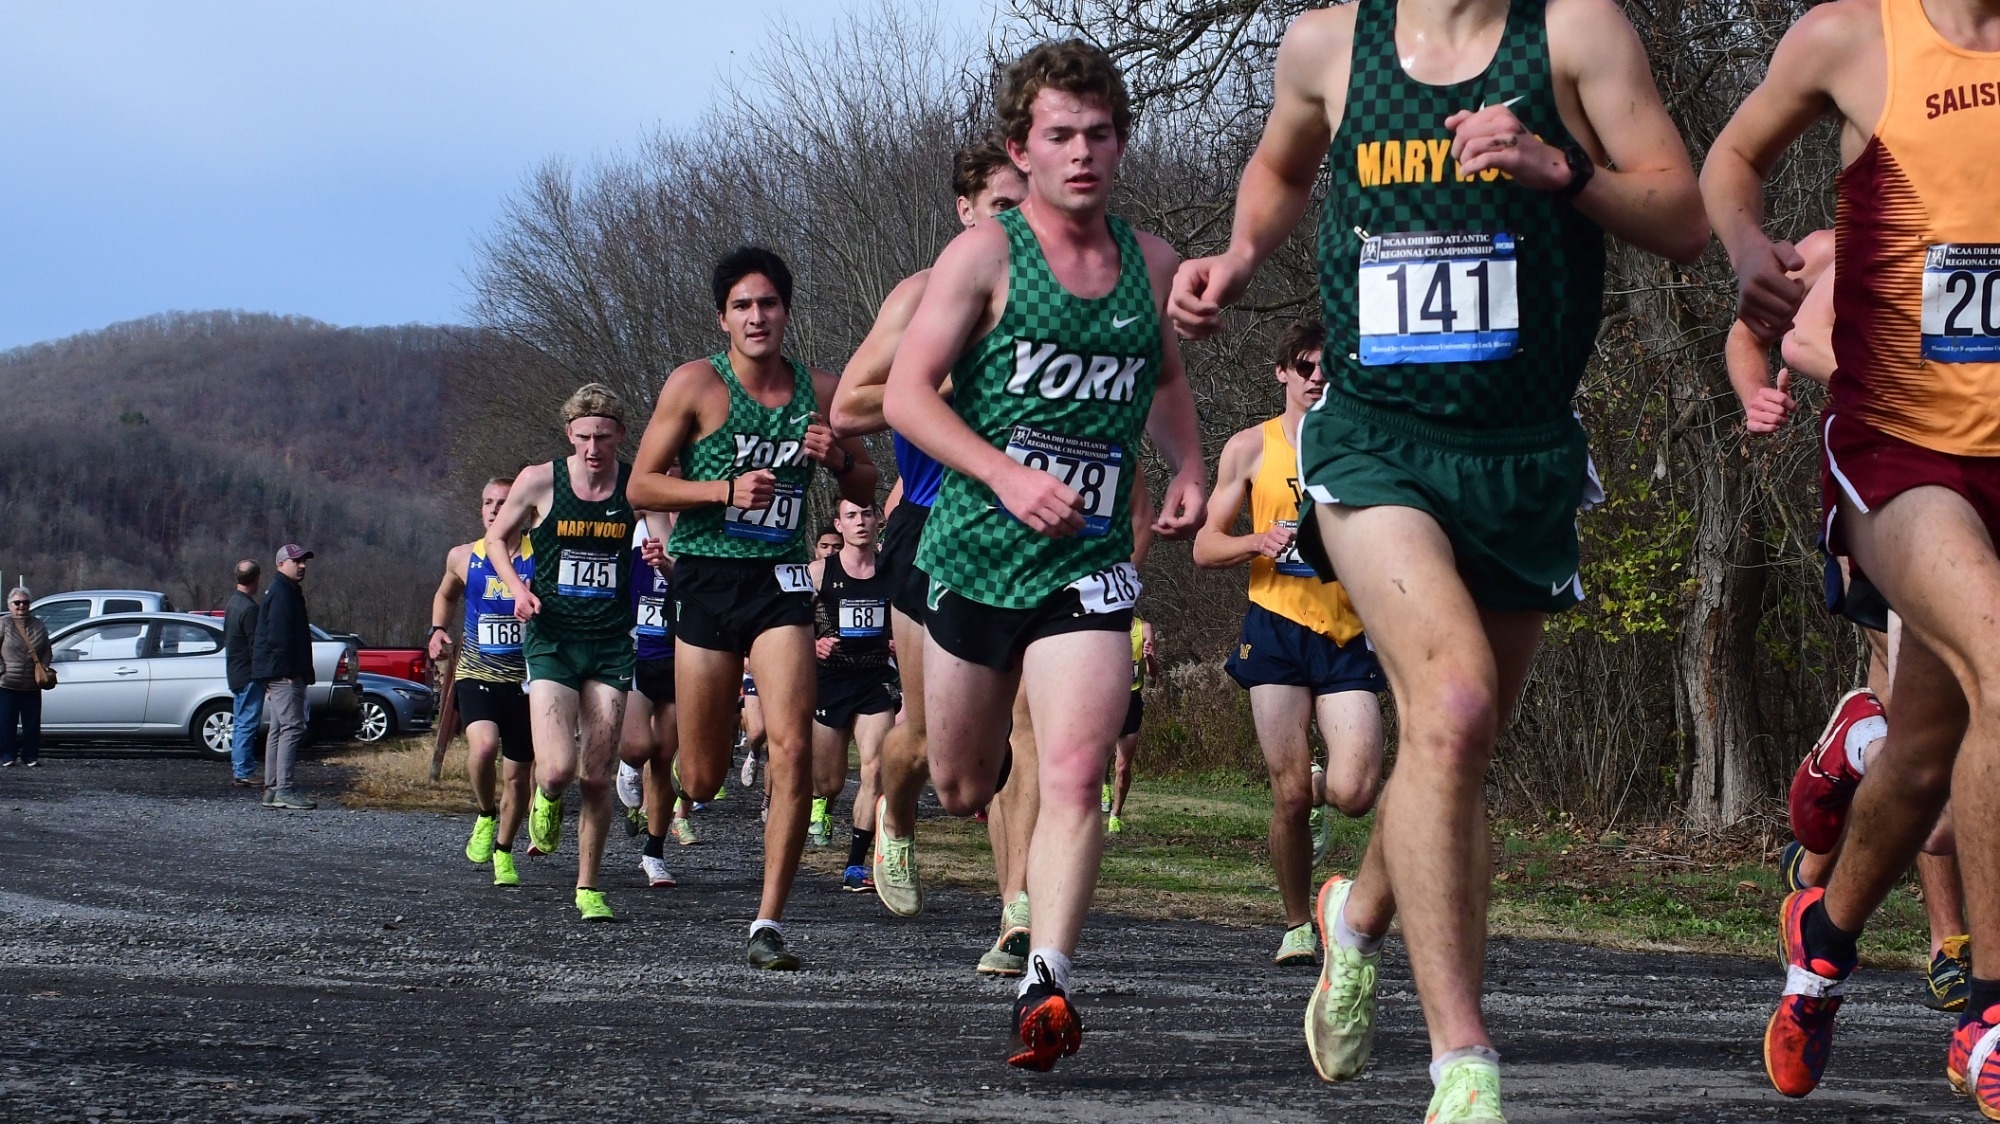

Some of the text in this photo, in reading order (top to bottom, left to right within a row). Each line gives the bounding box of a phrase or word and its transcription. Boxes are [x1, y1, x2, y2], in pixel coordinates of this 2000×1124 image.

[1926, 82, 2000, 120] SALIS
[1357, 134, 1543, 187] MARY
[1383, 234, 1490, 247] NCAA DIII MID ATLANTIC
[1948, 247, 1972, 255] NCAA
[1973, 247, 1989, 255] DIII
[1380, 246, 1494, 259] REGIONAL CHAMPIONSHIP
[1945, 258, 1987, 266] REGIONAL
[1387, 260, 1490, 335] 141
[1005, 337, 1146, 402] YORK
[1027, 439, 1110, 459] REGIONAL CHAMPIONSHIP
[1032, 431, 1051, 441] NCAA
[1065, 438, 1079, 446] MID
[1080, 440, 1108, 451] ATLANTIC
[557, 520, 627, 539] MARYWOOD
[571, 560, 610, 588] 145
[1091, 566, 1136, 605] 278
[853, 607, 874, 628] 68
[487, 623, 521, 645] 168
